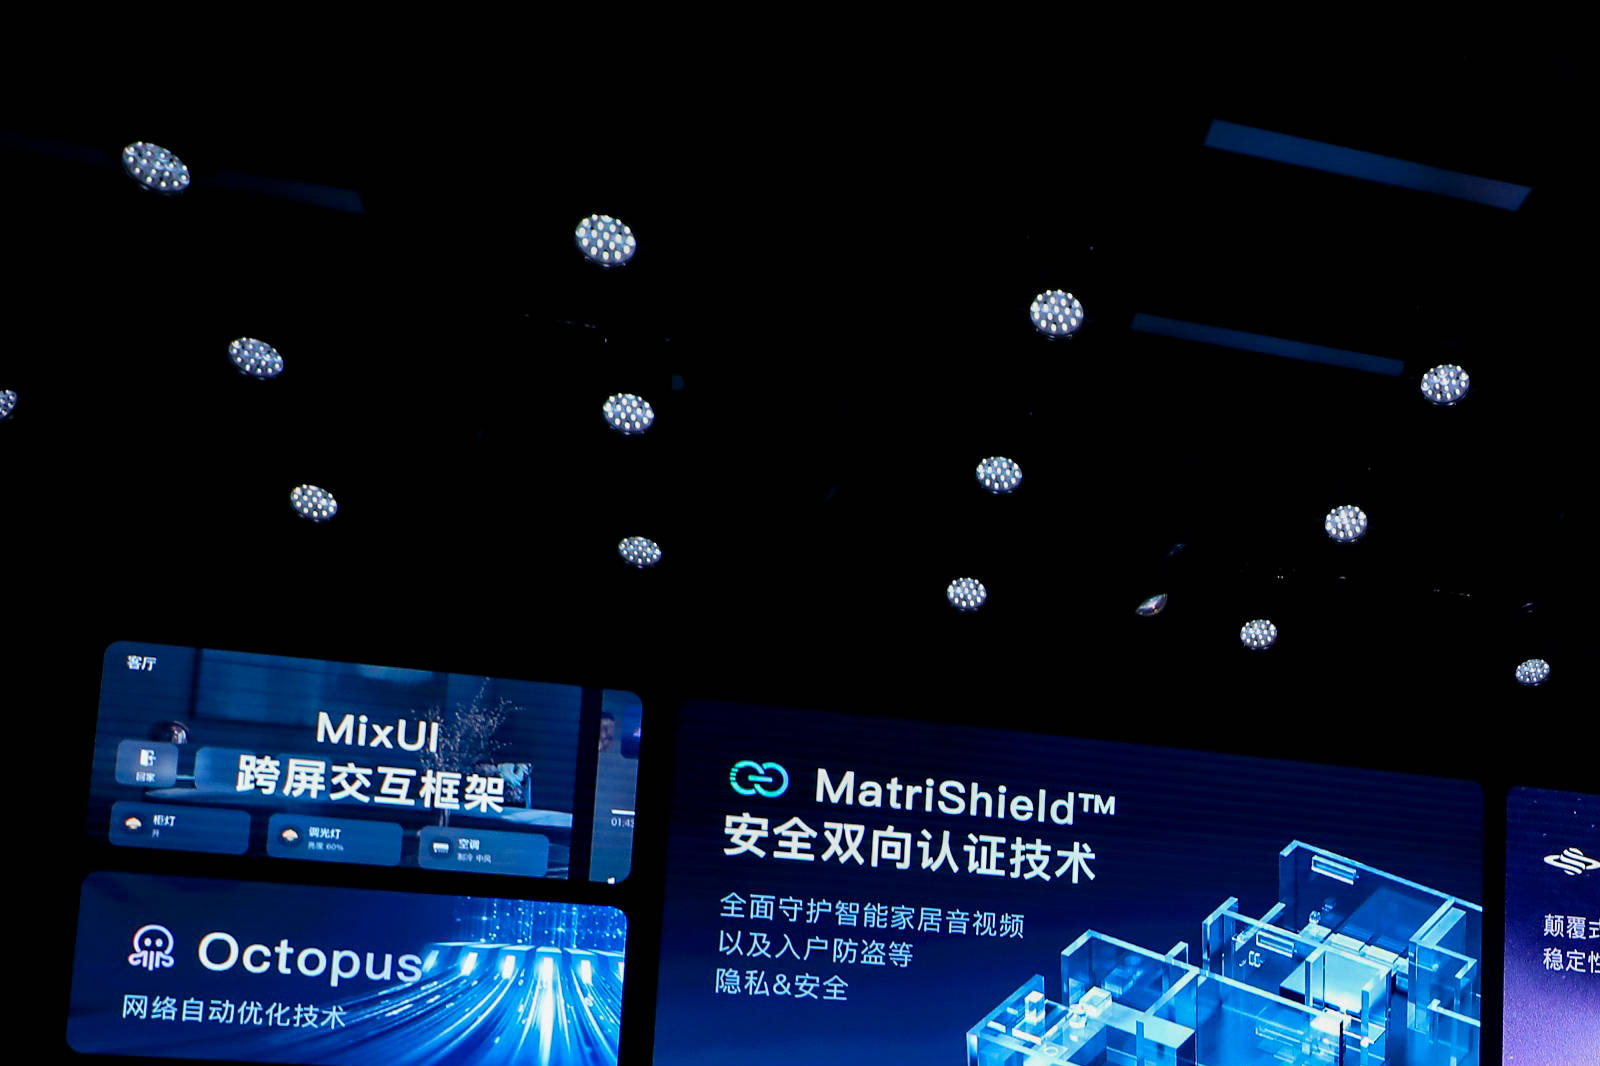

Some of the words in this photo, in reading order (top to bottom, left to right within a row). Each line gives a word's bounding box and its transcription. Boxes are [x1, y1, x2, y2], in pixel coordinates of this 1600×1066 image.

[126, 655, 157, 673] 客厅
[316, 711, 439, 754] MixUI
[235, 753, 505, 814] 跨屏交互框架
[309, 826, 341, 840] 调光灯
[723, 813, 1097, 885] 安全双向认证技术
[719, 892, 1025, 939] 全面守护智能家居音视频
[198, 932, 424, 986] Octopus
[718, 930, 914, 968] 以及入户防盗等
[714, 968, 850, 1003] 隐私&安全
[121, 993, 347, 1030] 网络自动优化技术
